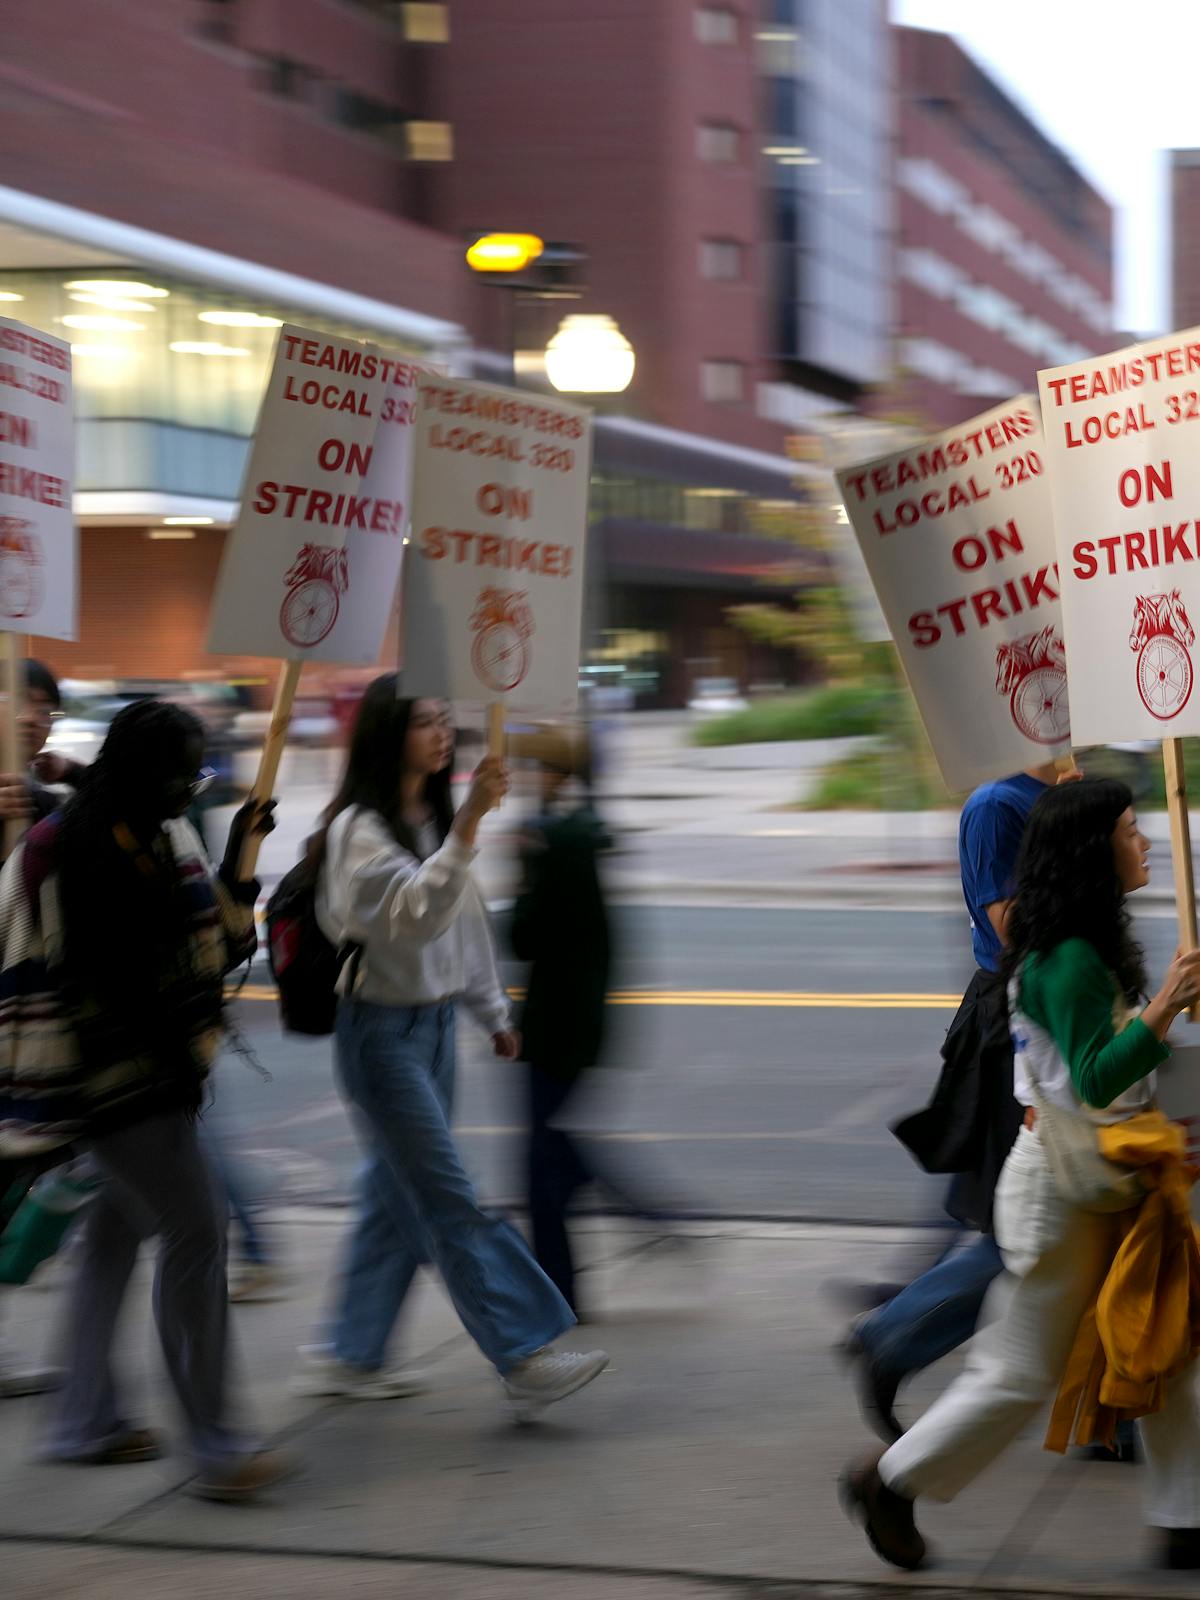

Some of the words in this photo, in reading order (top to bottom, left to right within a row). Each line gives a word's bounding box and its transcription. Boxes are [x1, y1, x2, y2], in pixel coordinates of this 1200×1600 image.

[0, 325, 71, 372] STERS
[283, 335, 420, 388] TEAMSTER
[284, 376, 372, 417] LOCAL
[419, 385, 584, 440] TEAMSTERS
[429, 423, 527, 461] LOCAL
[529, 441, 575, 472] 320
[1064, 402, 1156, 449] LOCAL
[318, 438, 373, 477] ON
[846, 408, 1037, 502] TEAMSTERS
[253, 481, 403, 535] STRIKE!
[477, 482, 534, 521] ON
[873, 475, 991, 537] LOCAL
[995, 449, 1045, 490] 320
[1118, 460, 1174, 508] ON
[420, 525, 574, 578] STRIKE!
[951, 518, 1024, 573] ON
[907, 562, 1060, 649] STRIK
